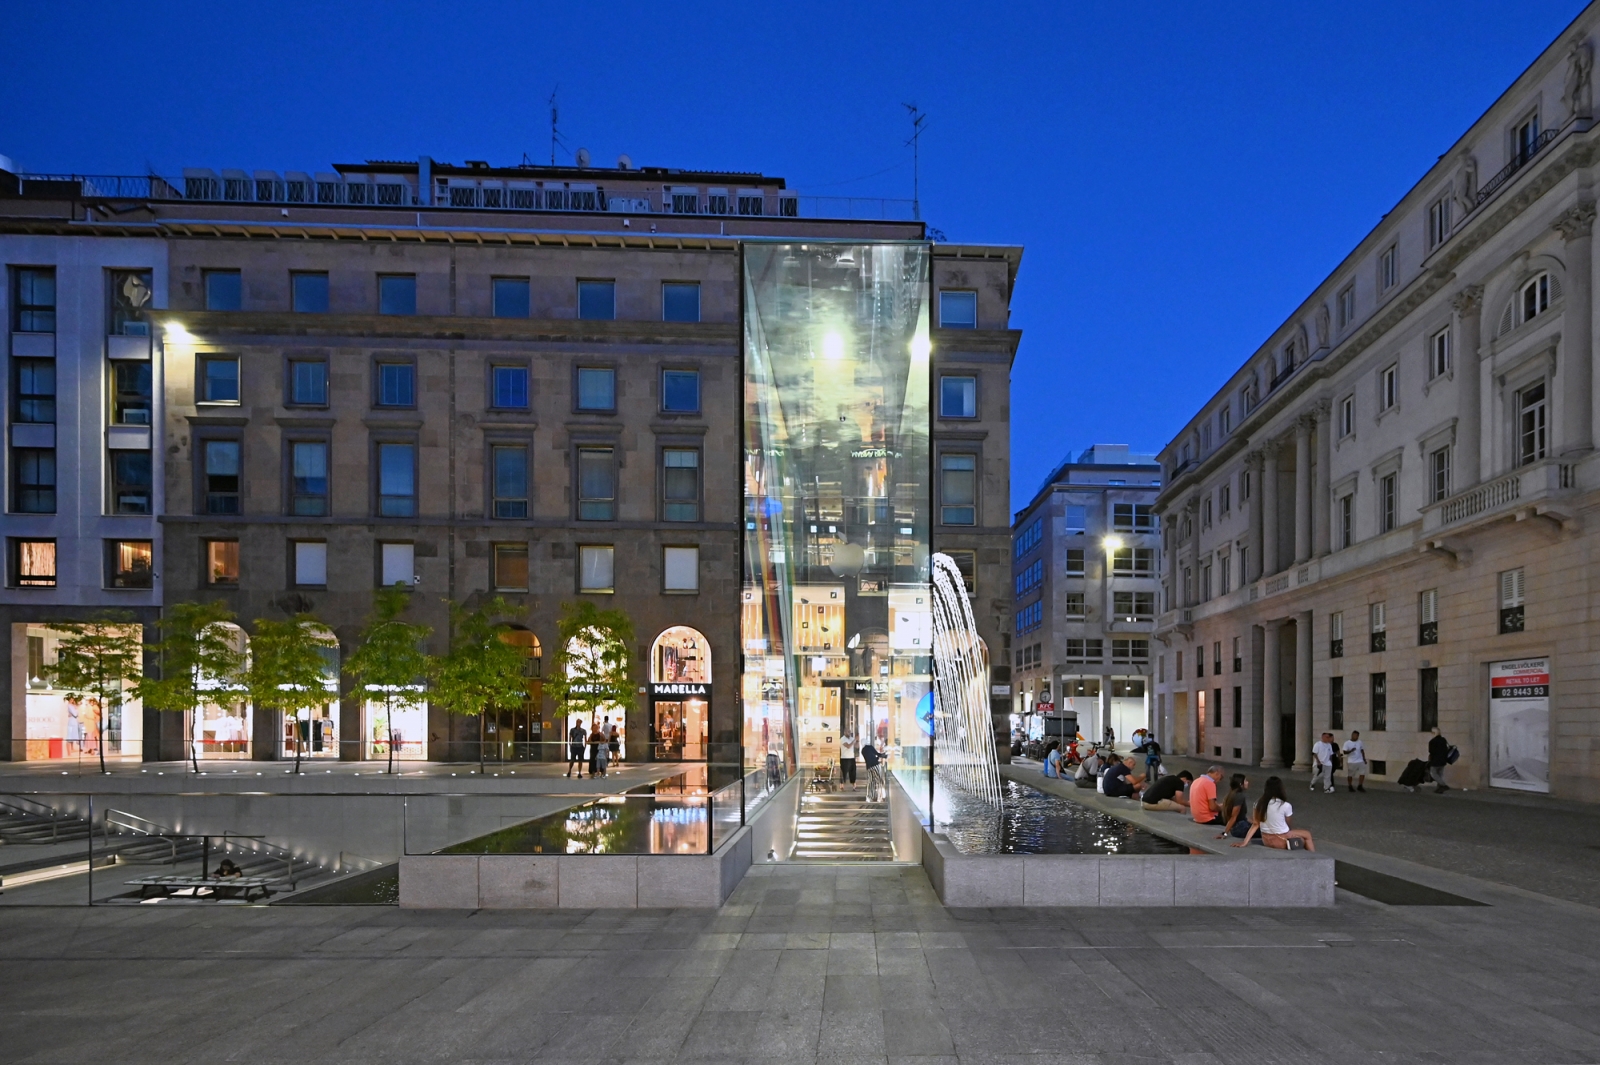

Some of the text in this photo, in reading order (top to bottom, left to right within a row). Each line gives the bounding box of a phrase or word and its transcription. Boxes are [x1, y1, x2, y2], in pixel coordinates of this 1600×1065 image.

[654, 684, 706, 694] MARELLA
[1501, 686, 1545, 697] 02 9443 93
